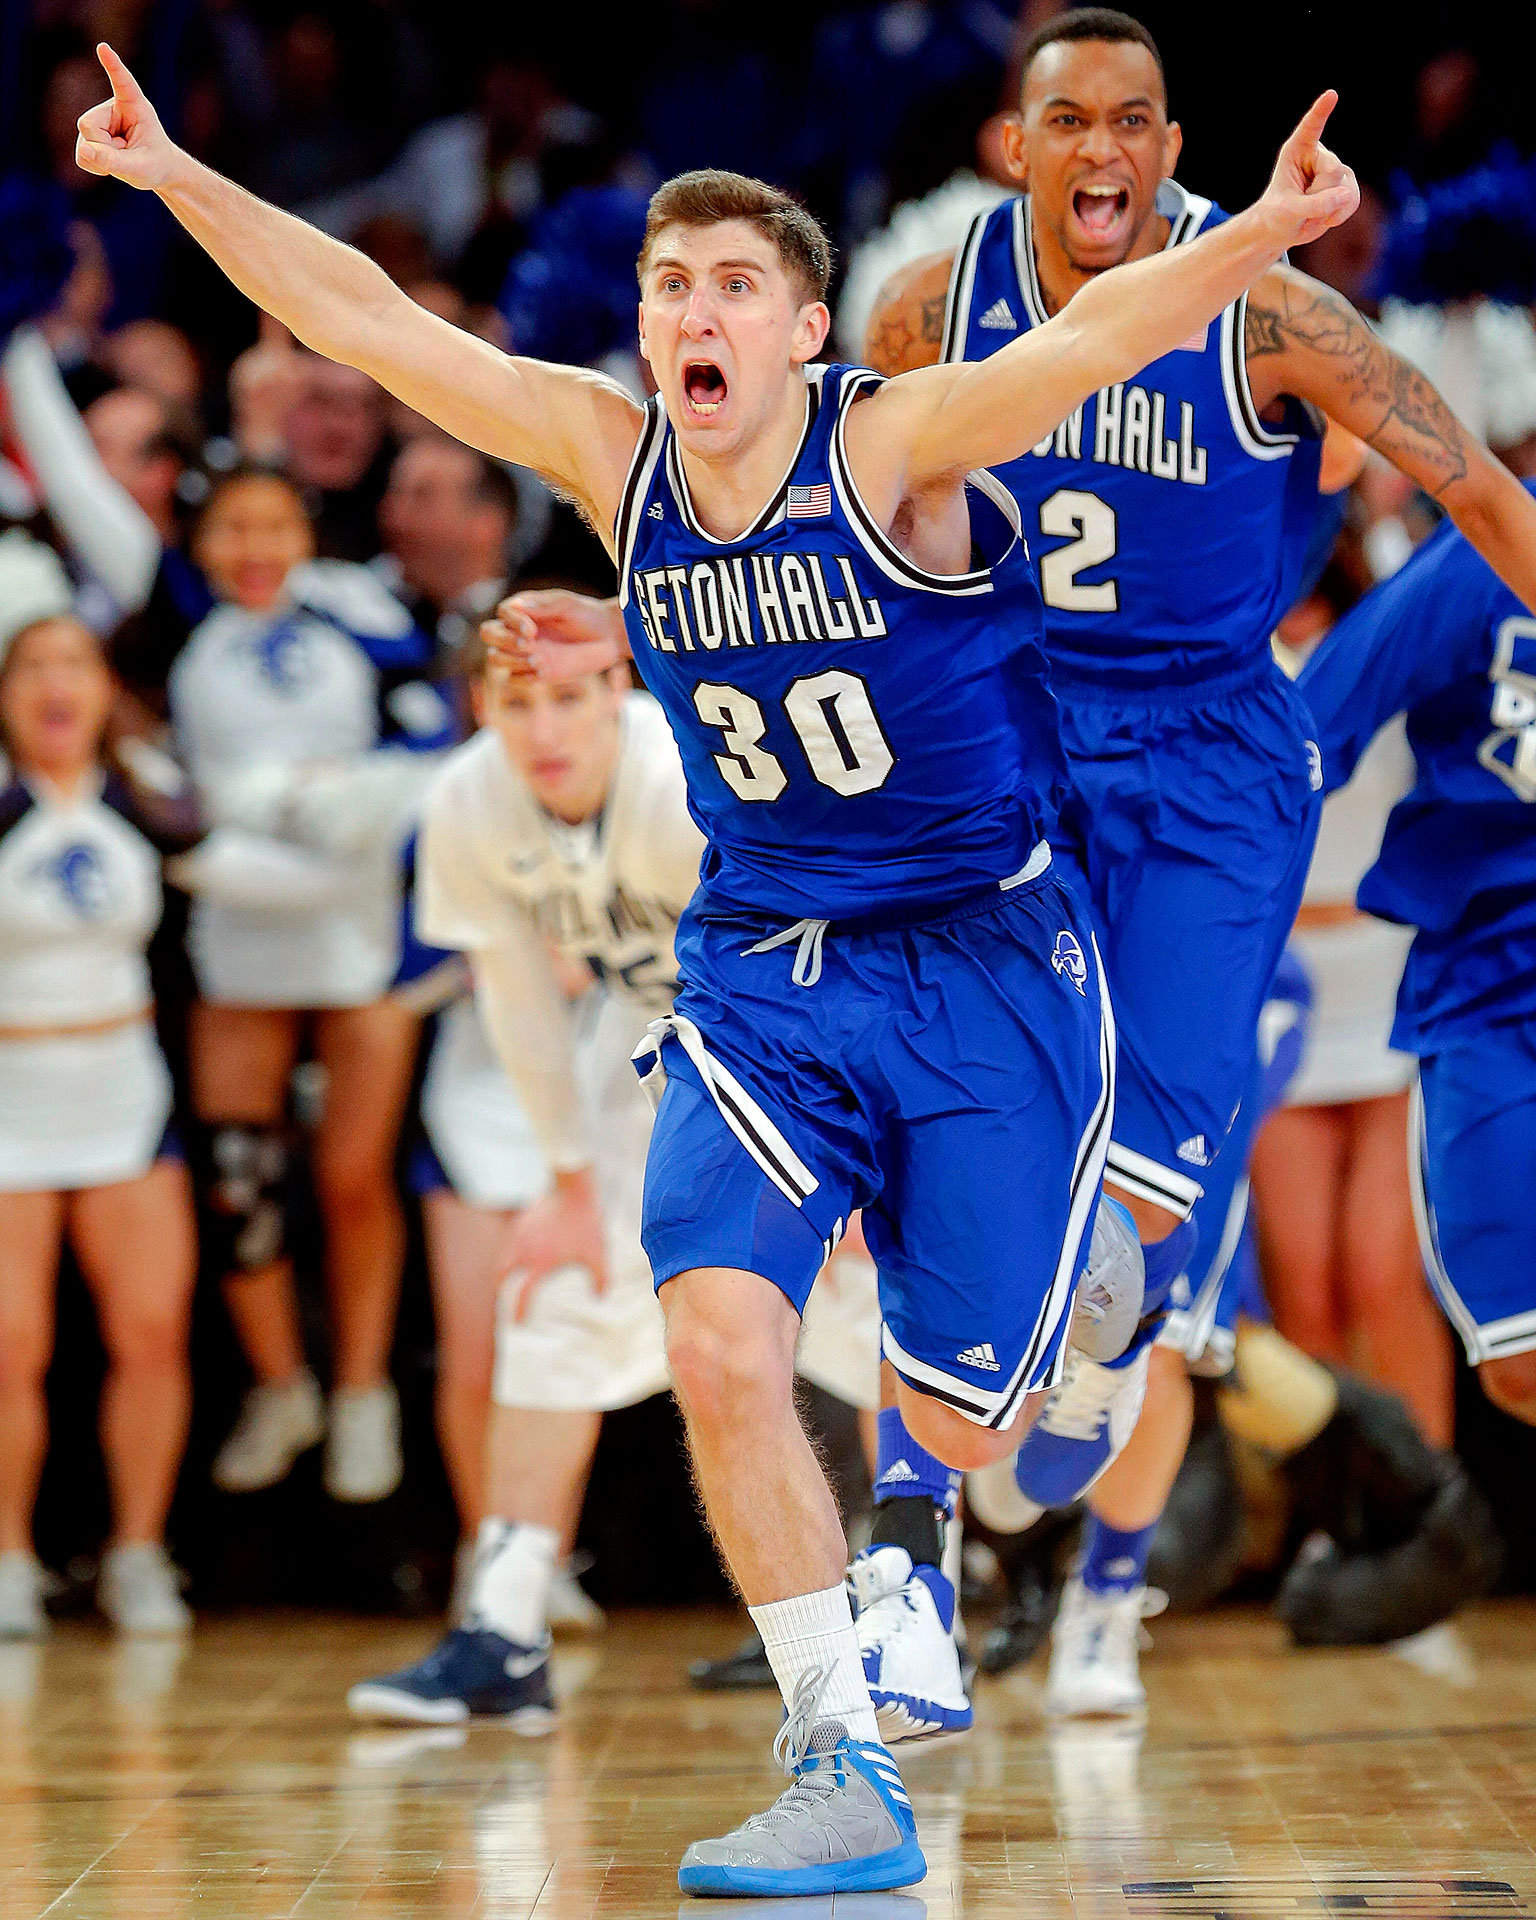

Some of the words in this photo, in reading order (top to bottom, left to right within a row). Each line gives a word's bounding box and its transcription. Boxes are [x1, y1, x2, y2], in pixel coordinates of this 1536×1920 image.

[1093, 381, 1207, 486] HALL
[1040, 488, 1120, 613] 2
[634, 557, 755, 654] SETON
[752, 553, 888, 646] HALL
[692, 666, 899, 803] 30
[956, 1353, 1001, 1372] adidas
